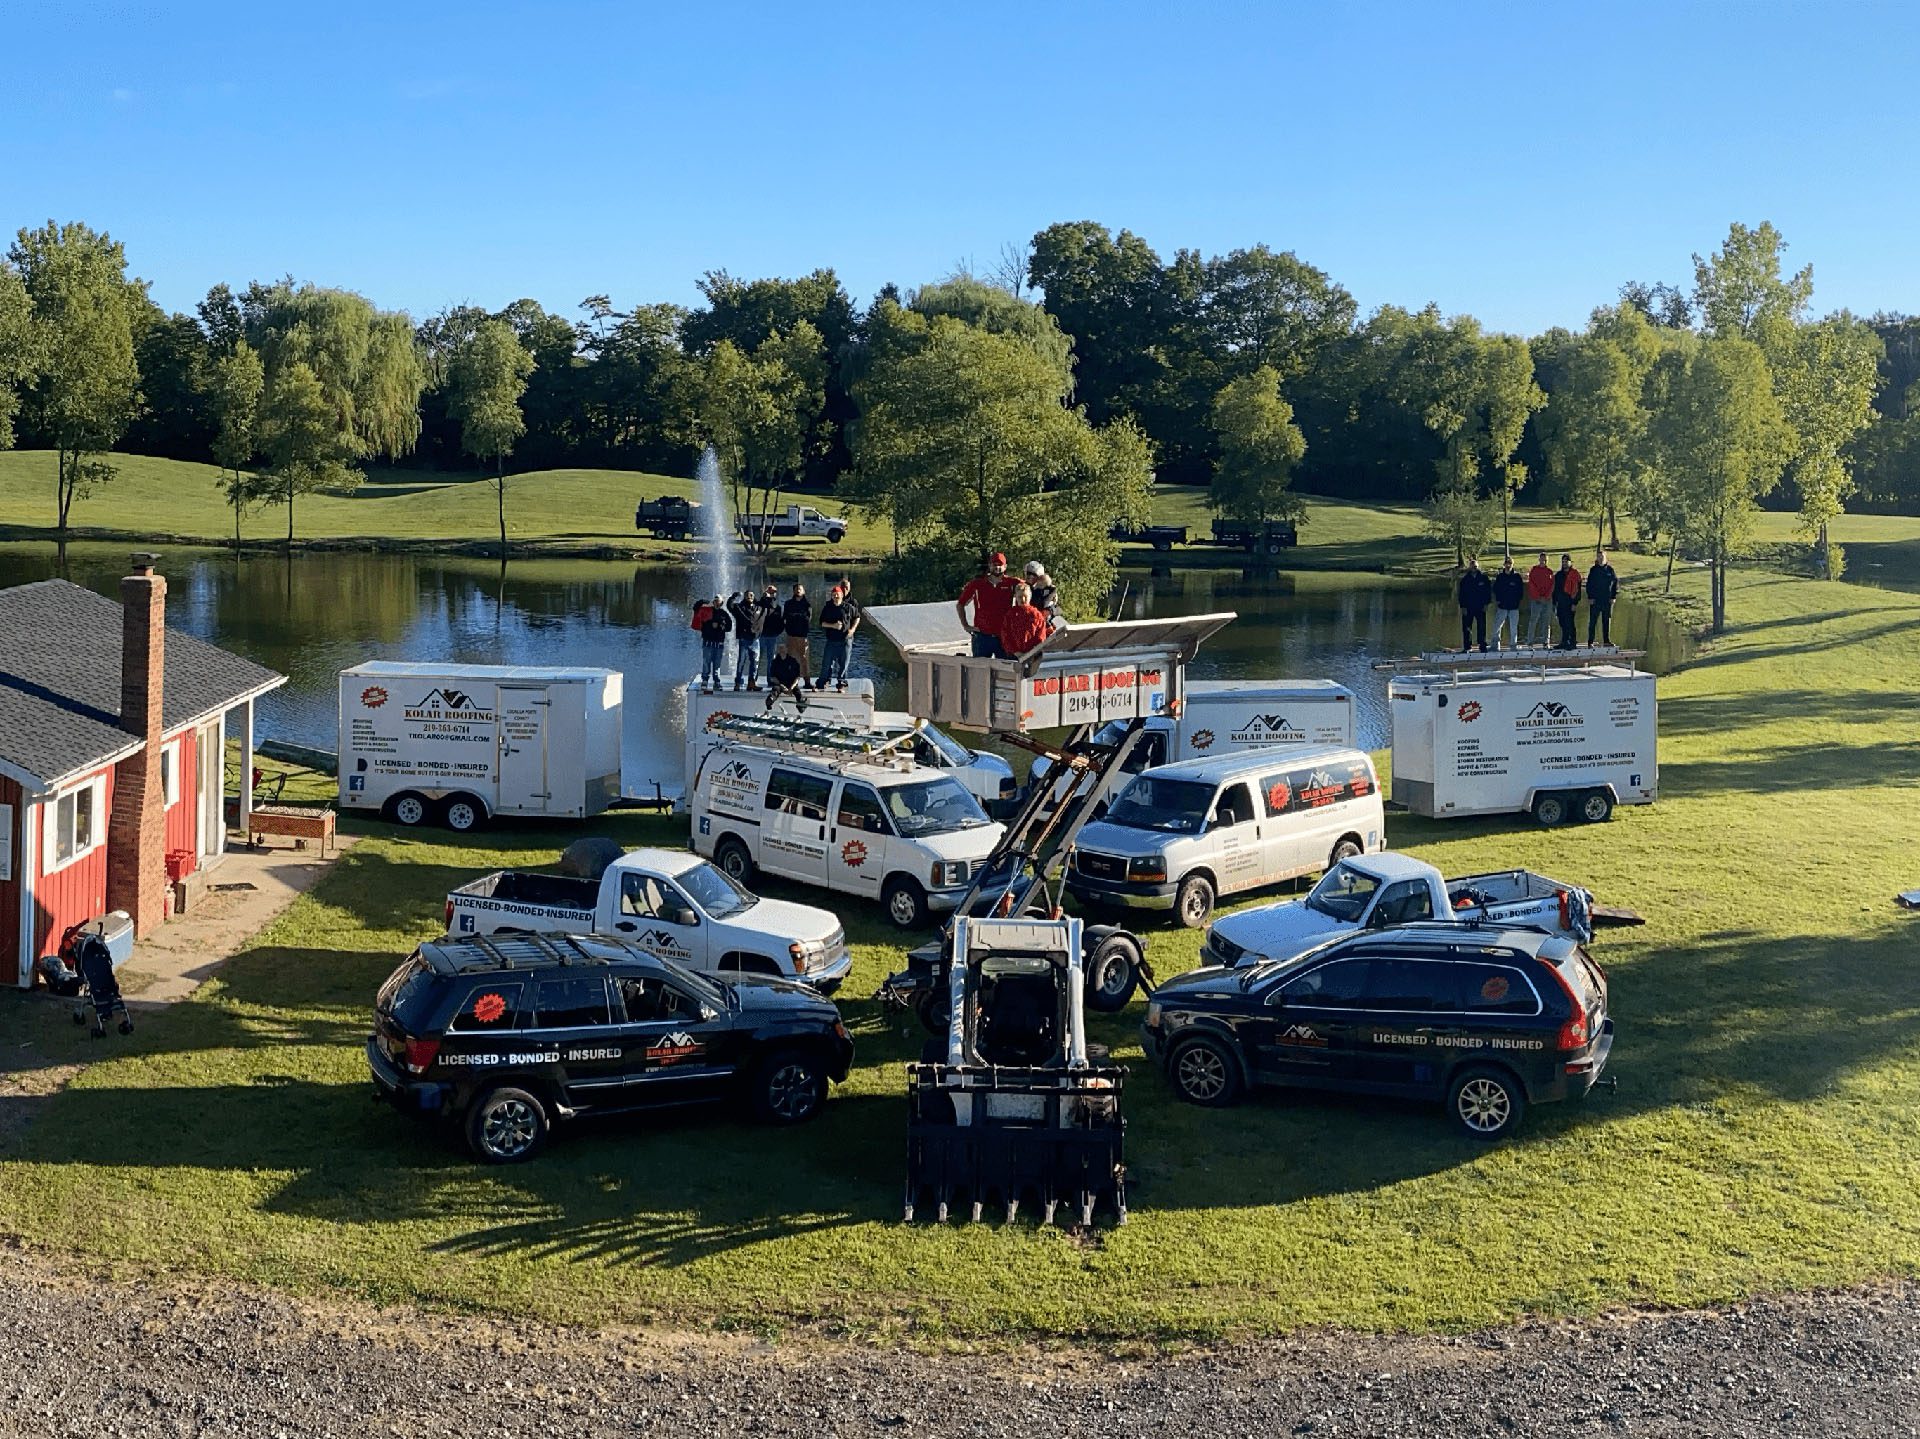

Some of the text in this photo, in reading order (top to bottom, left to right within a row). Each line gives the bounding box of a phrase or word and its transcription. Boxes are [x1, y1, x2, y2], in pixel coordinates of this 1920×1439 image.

[1033, 674, 1090, 696] KOLAR
[404, 709, 492, 720] KOLAR ROOFING
[1516, 717, 1584, 728] KOLAR ROOFING
[1231, 732, 1306, 741] KOLAR ROOFING
[374, 759, 488, 771] LICENSED BONDED INSURED
[1540, 756, 1572, 764] LICENSED
[455, 897, 592, 922] LICENSED BONDED INSURED
[1510, 907, 1543, 917] BONDED
[1373, 1033, 1543, 1050] LICENSED BONDED INSURED
[438, 1048, 622, 1066] LICENSED BONDED INSURED
